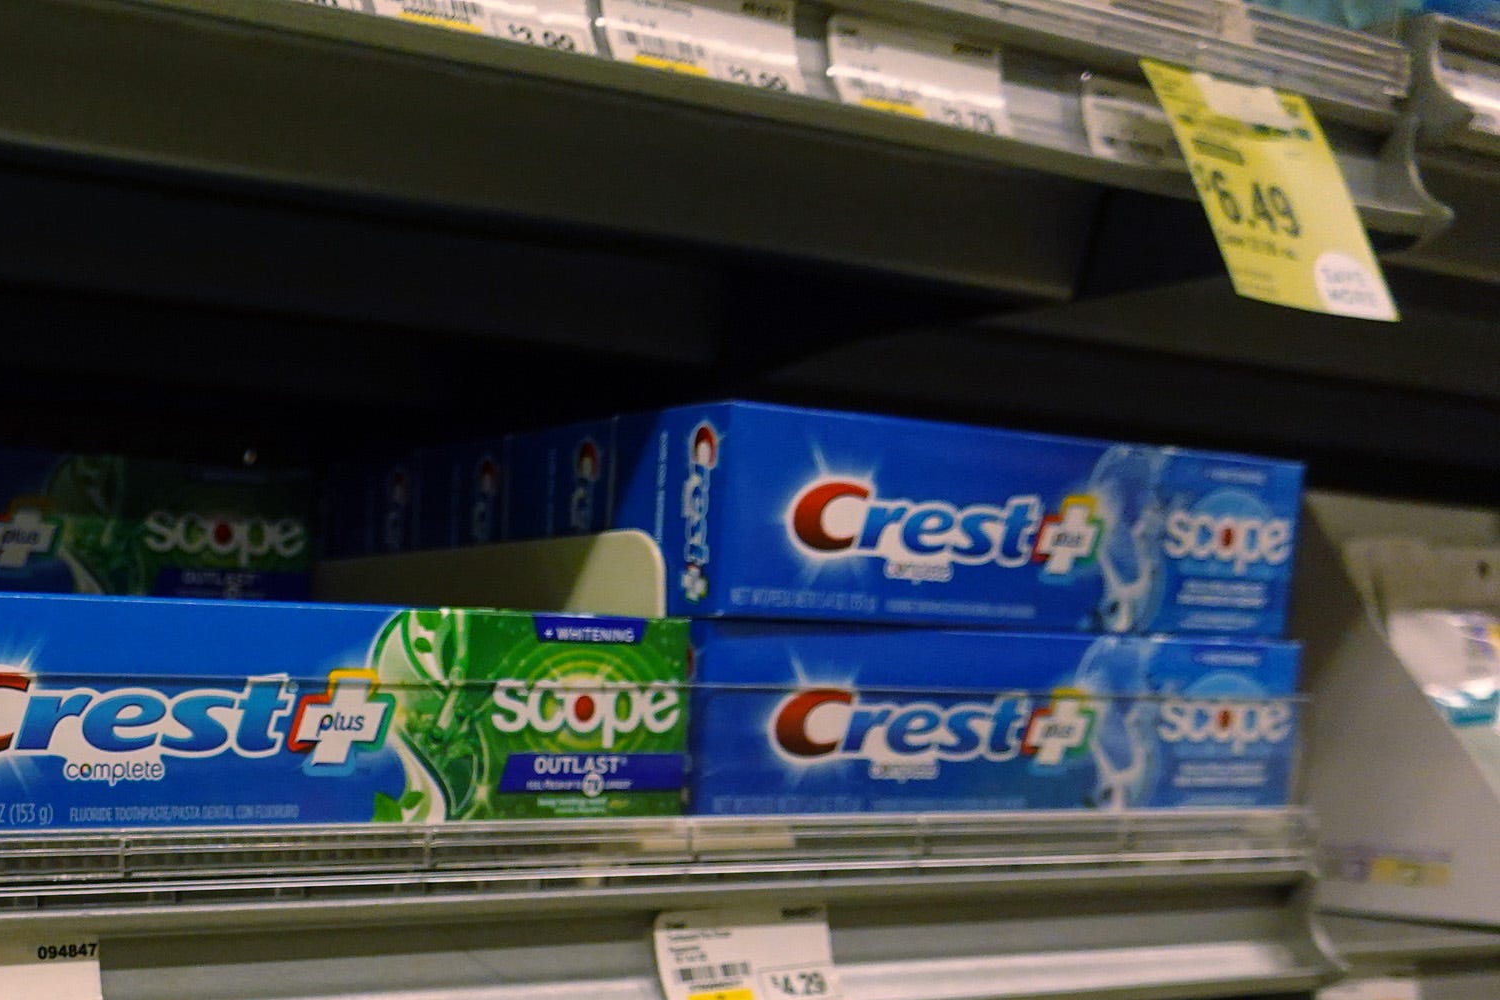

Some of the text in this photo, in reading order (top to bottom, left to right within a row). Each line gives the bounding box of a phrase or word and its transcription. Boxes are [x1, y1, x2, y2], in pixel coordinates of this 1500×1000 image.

[145, 510, 304, 566] scope
[791, 480, 1040, 566] Crest
[1165, 511, 1292, 571] scope
[556, 627, 636, 644] WHITENING
[316, 713, 365, 737] plus
[492, 677, 681, 749] scope
[773, 687, 1029, 762] Crest
[1159, 699, 1292, 752] scope
[65, 759, 165, 784] complete
[533, 755, 619, 776] OUTLAST
[10, 802, 36, 827] (153
[40, 803, 54, 826] g)
[37, 943, 98, 960] 094847
